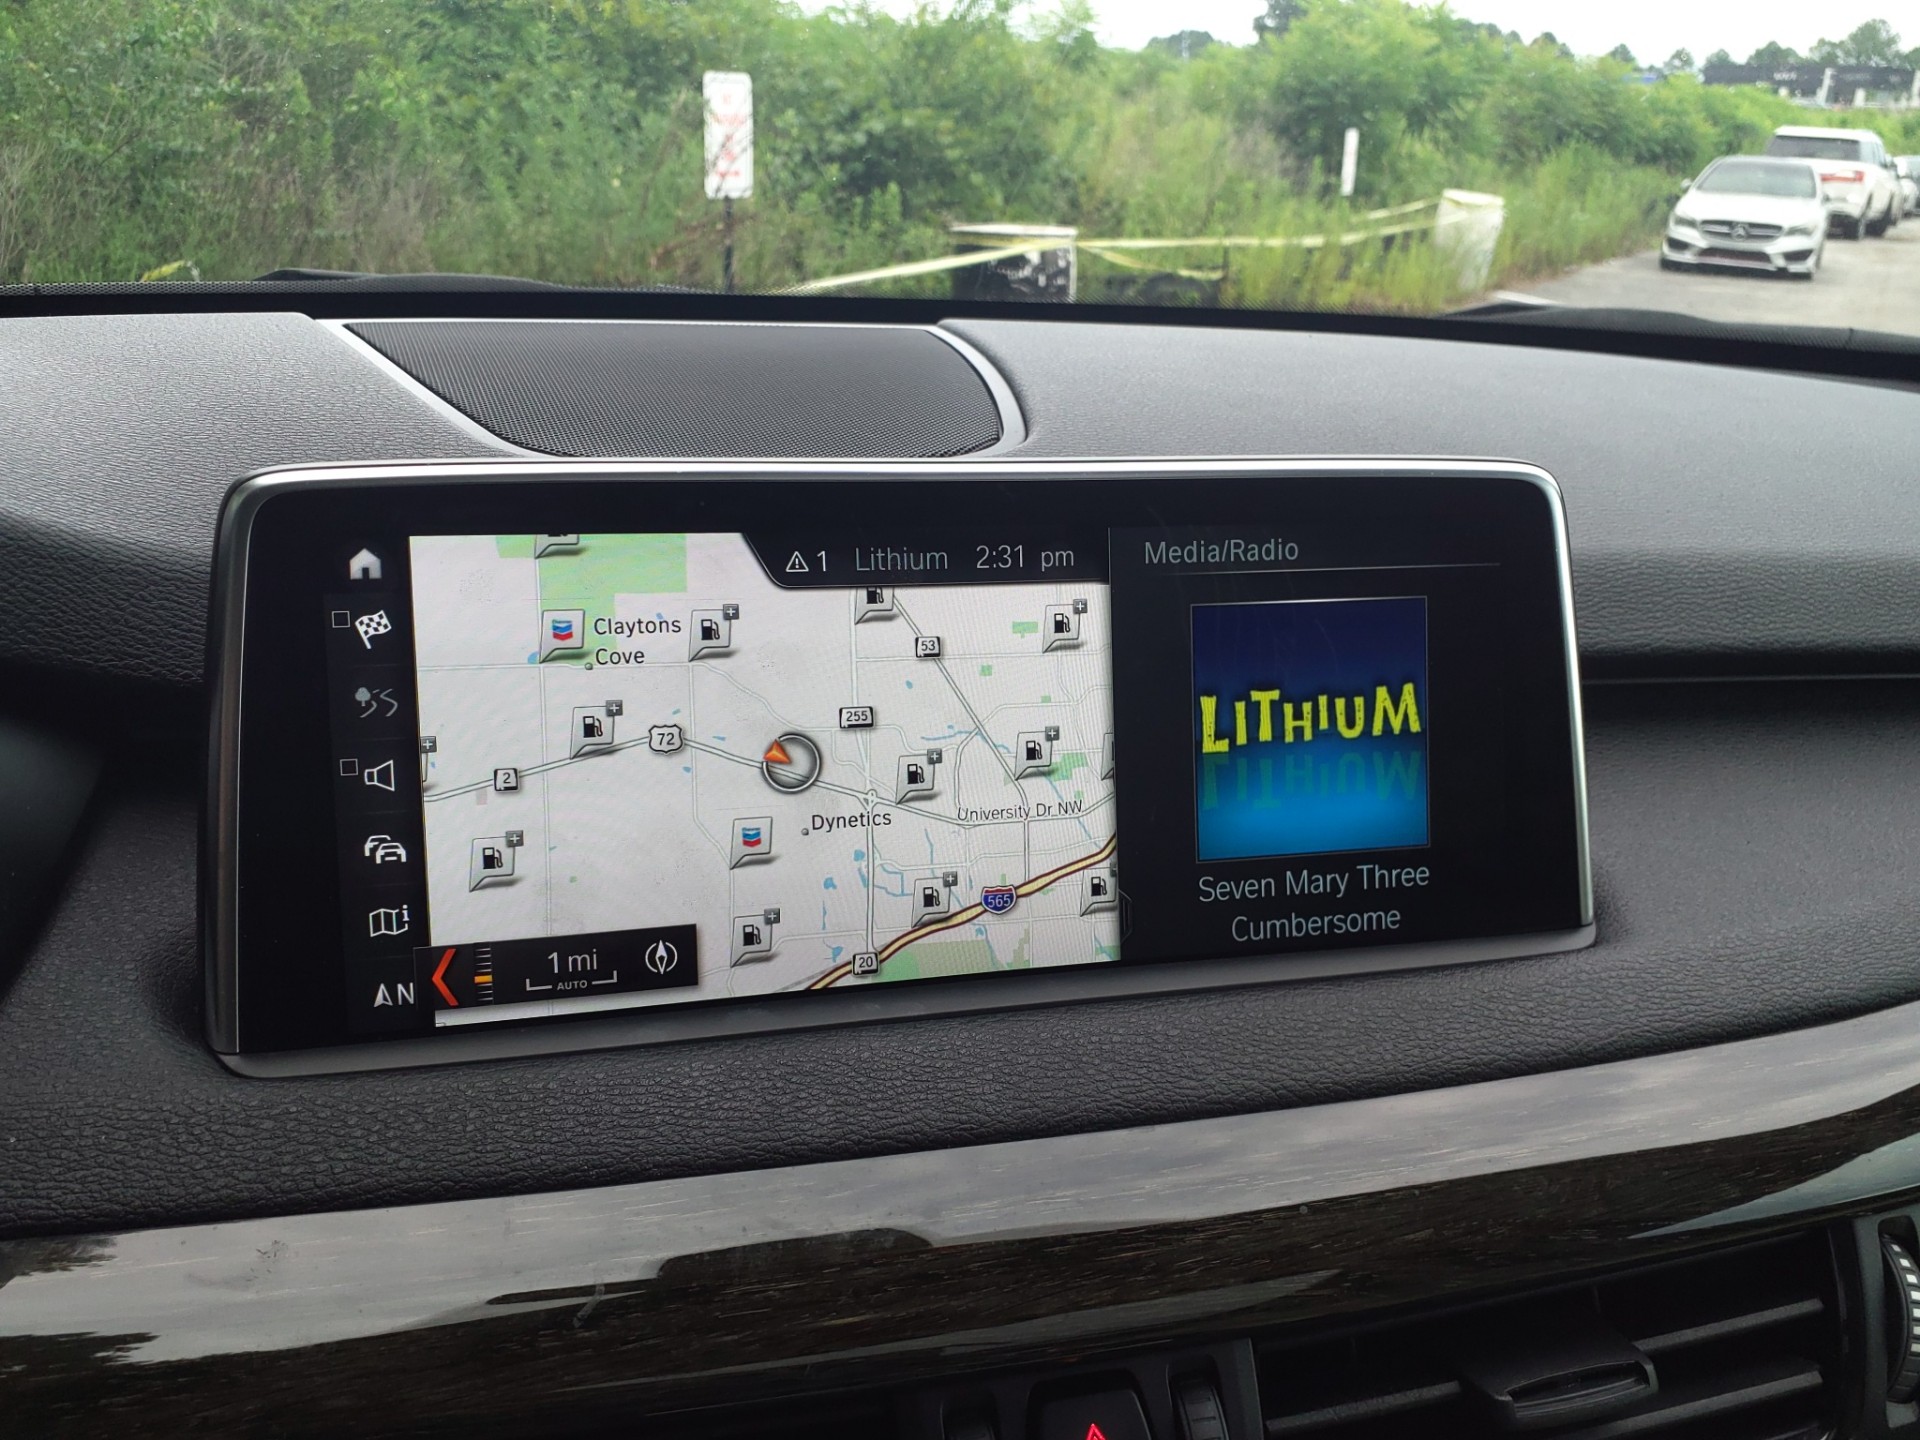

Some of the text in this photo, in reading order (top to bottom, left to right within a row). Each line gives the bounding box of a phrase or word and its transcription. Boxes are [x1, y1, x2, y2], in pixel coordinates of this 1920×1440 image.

[817, 551, 828, 572] 1
[855, 547, 948, 571] Lithium
[976, 544, 1075, 572] 2:31 pm
[1144, 538, 1299, 565] Media/Radio
[594, 615, 681, 637] Claytons
[920, 639, 936, 652] 53
[595, 647, 645, 666] Cove
[845, 710, 868, 723] 255
[1200, 682, 1421, 753] LITHIUM
[656, 732, 675, 747] 72
[502, 771, 511, 785] 2
[811, 811, 892, 831] Dynetics
[957, 800, 1083, 822] University Dr NW
[1198, 865, 1430, 902] Seven Mary Three
[987, 893, 1012, 908] 565
[1231, 909, 1401, 942] Cumbersome
[547, 948, 598, 974] 1 mi
[858, 956, 874, 969] 20
[557, 979, 588, 991] AUTO
